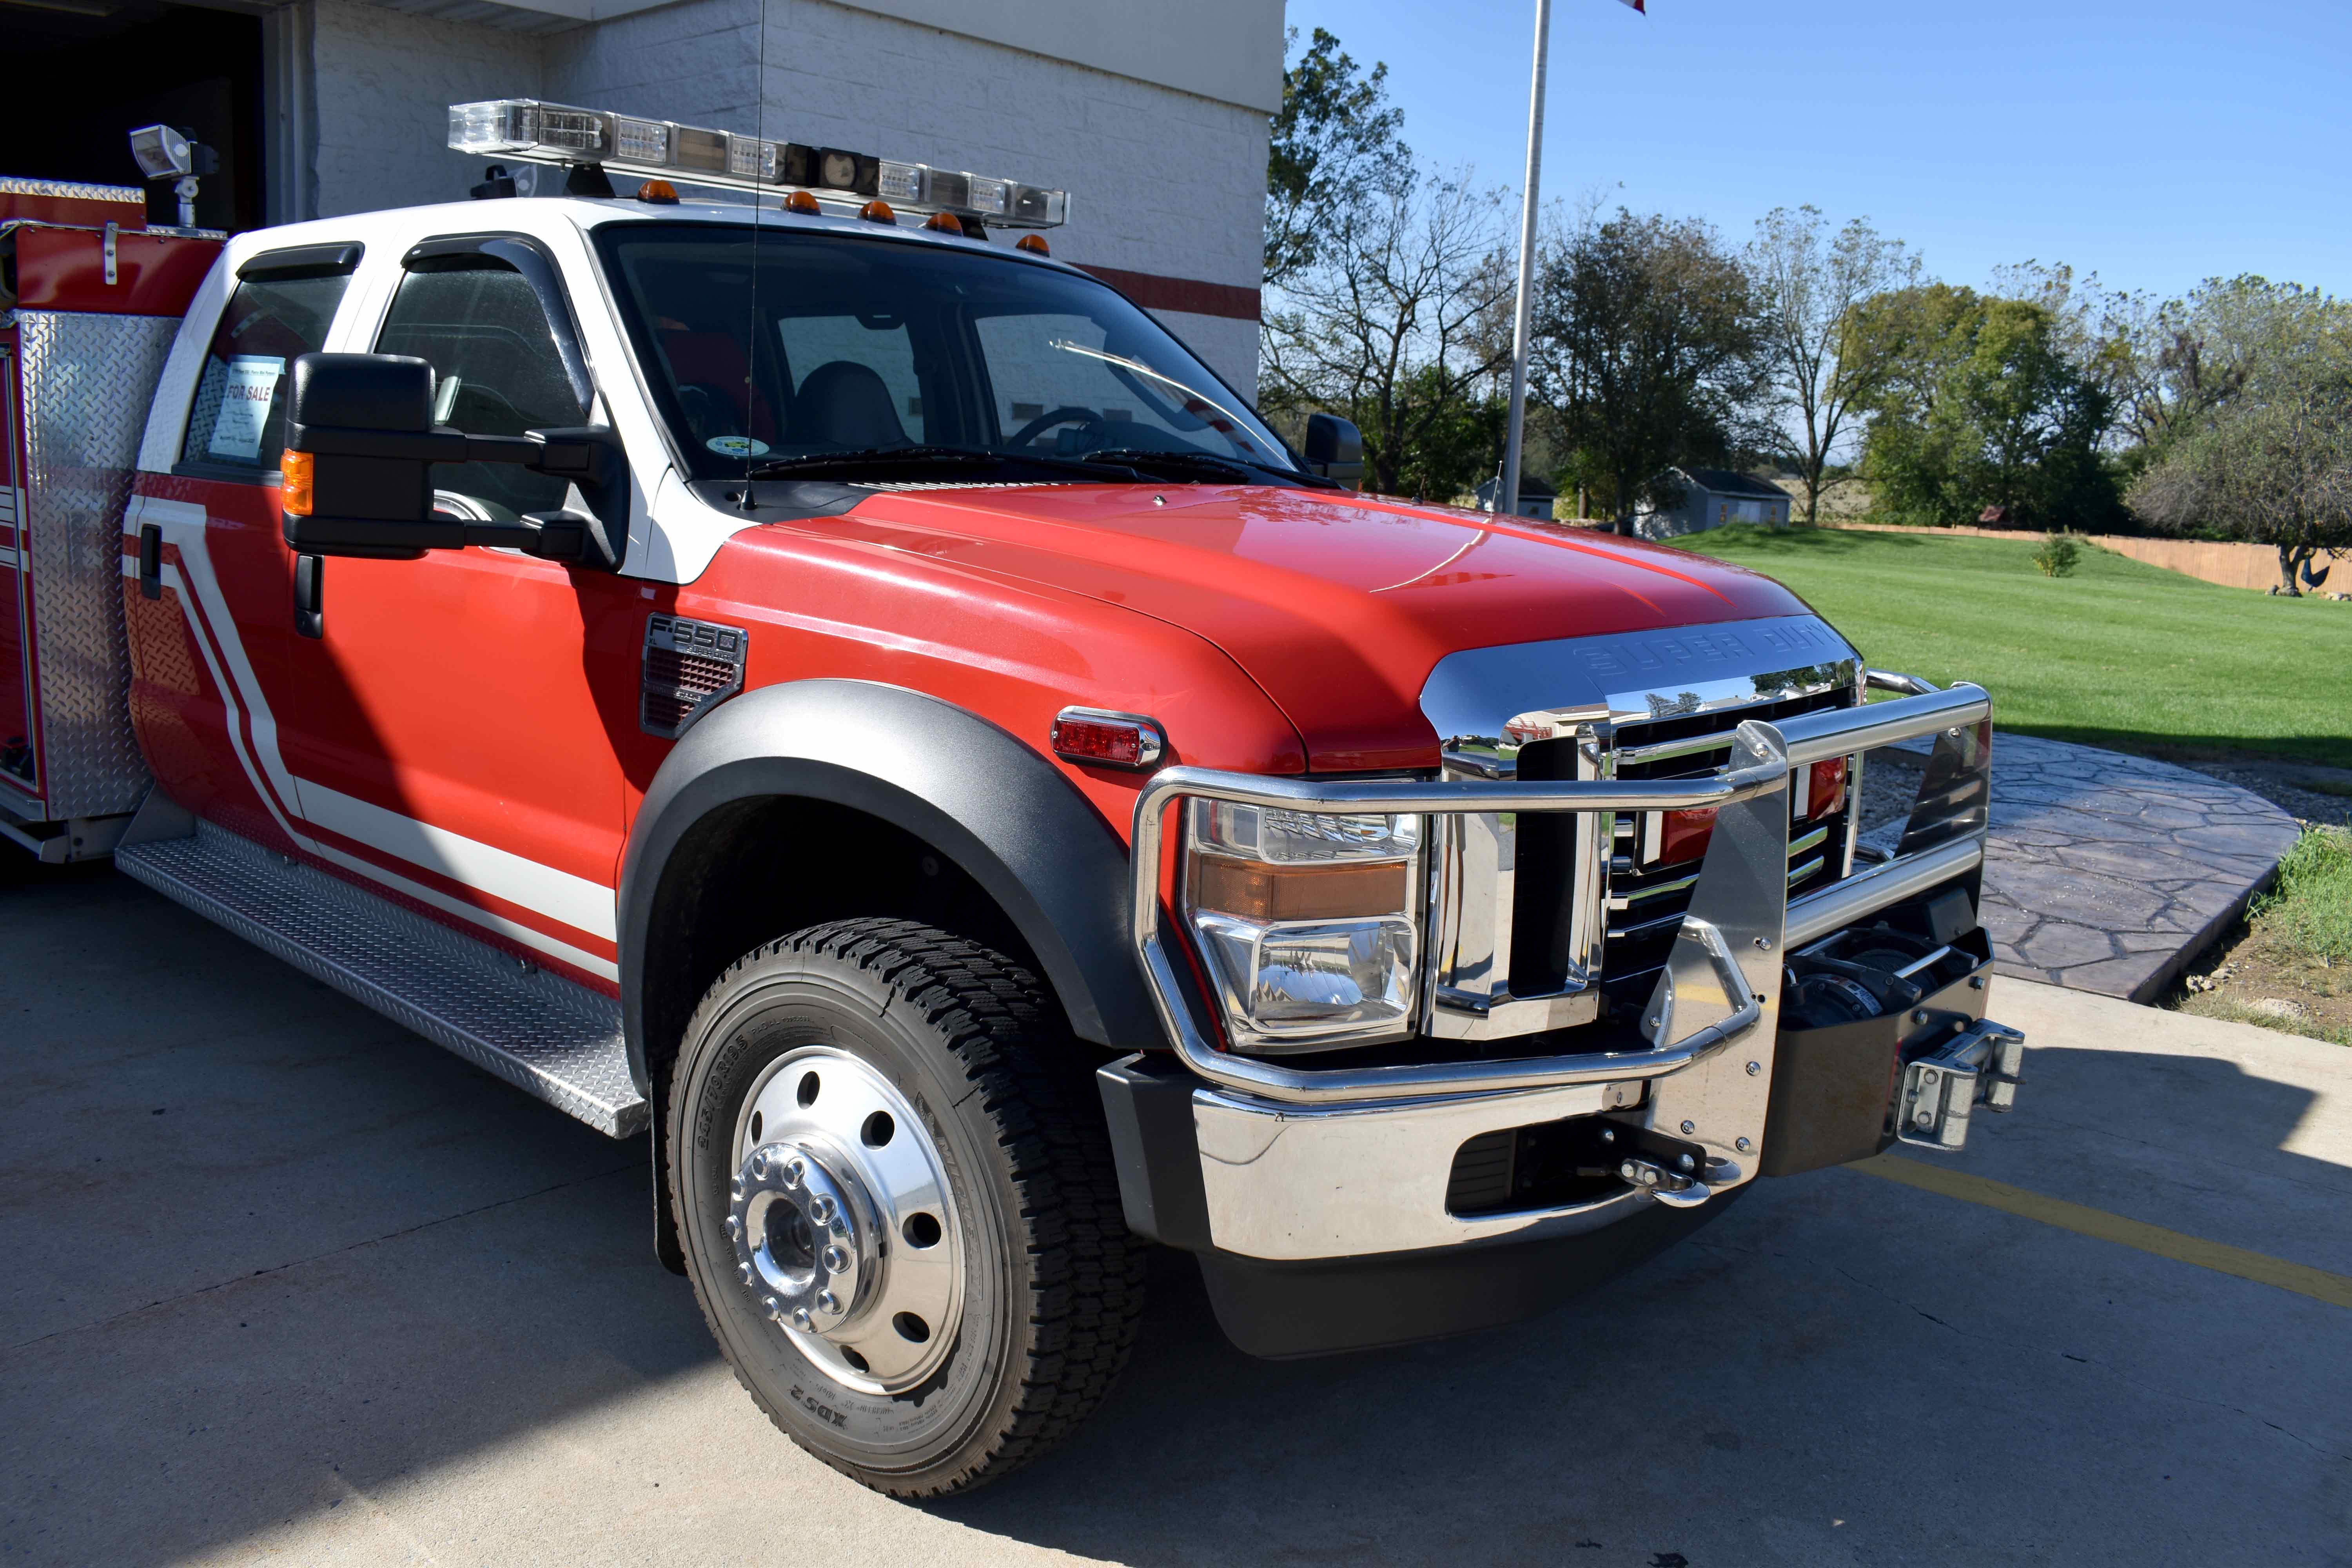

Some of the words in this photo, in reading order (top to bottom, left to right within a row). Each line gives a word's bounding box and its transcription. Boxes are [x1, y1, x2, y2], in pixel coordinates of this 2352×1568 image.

[227, 384, 245, 400] FOR
[246, 385, 270, 401] SALE
[686, 647, 712, 658] SUPER
[713, 652, 735, 662] DUTY
[1573, 632, 1755, 676] SUPER
[1753, 623, 1838, 653] DUTY
[790, 1384, 804, 1401] 2
[804, 1396, 848, 1430] XDS
